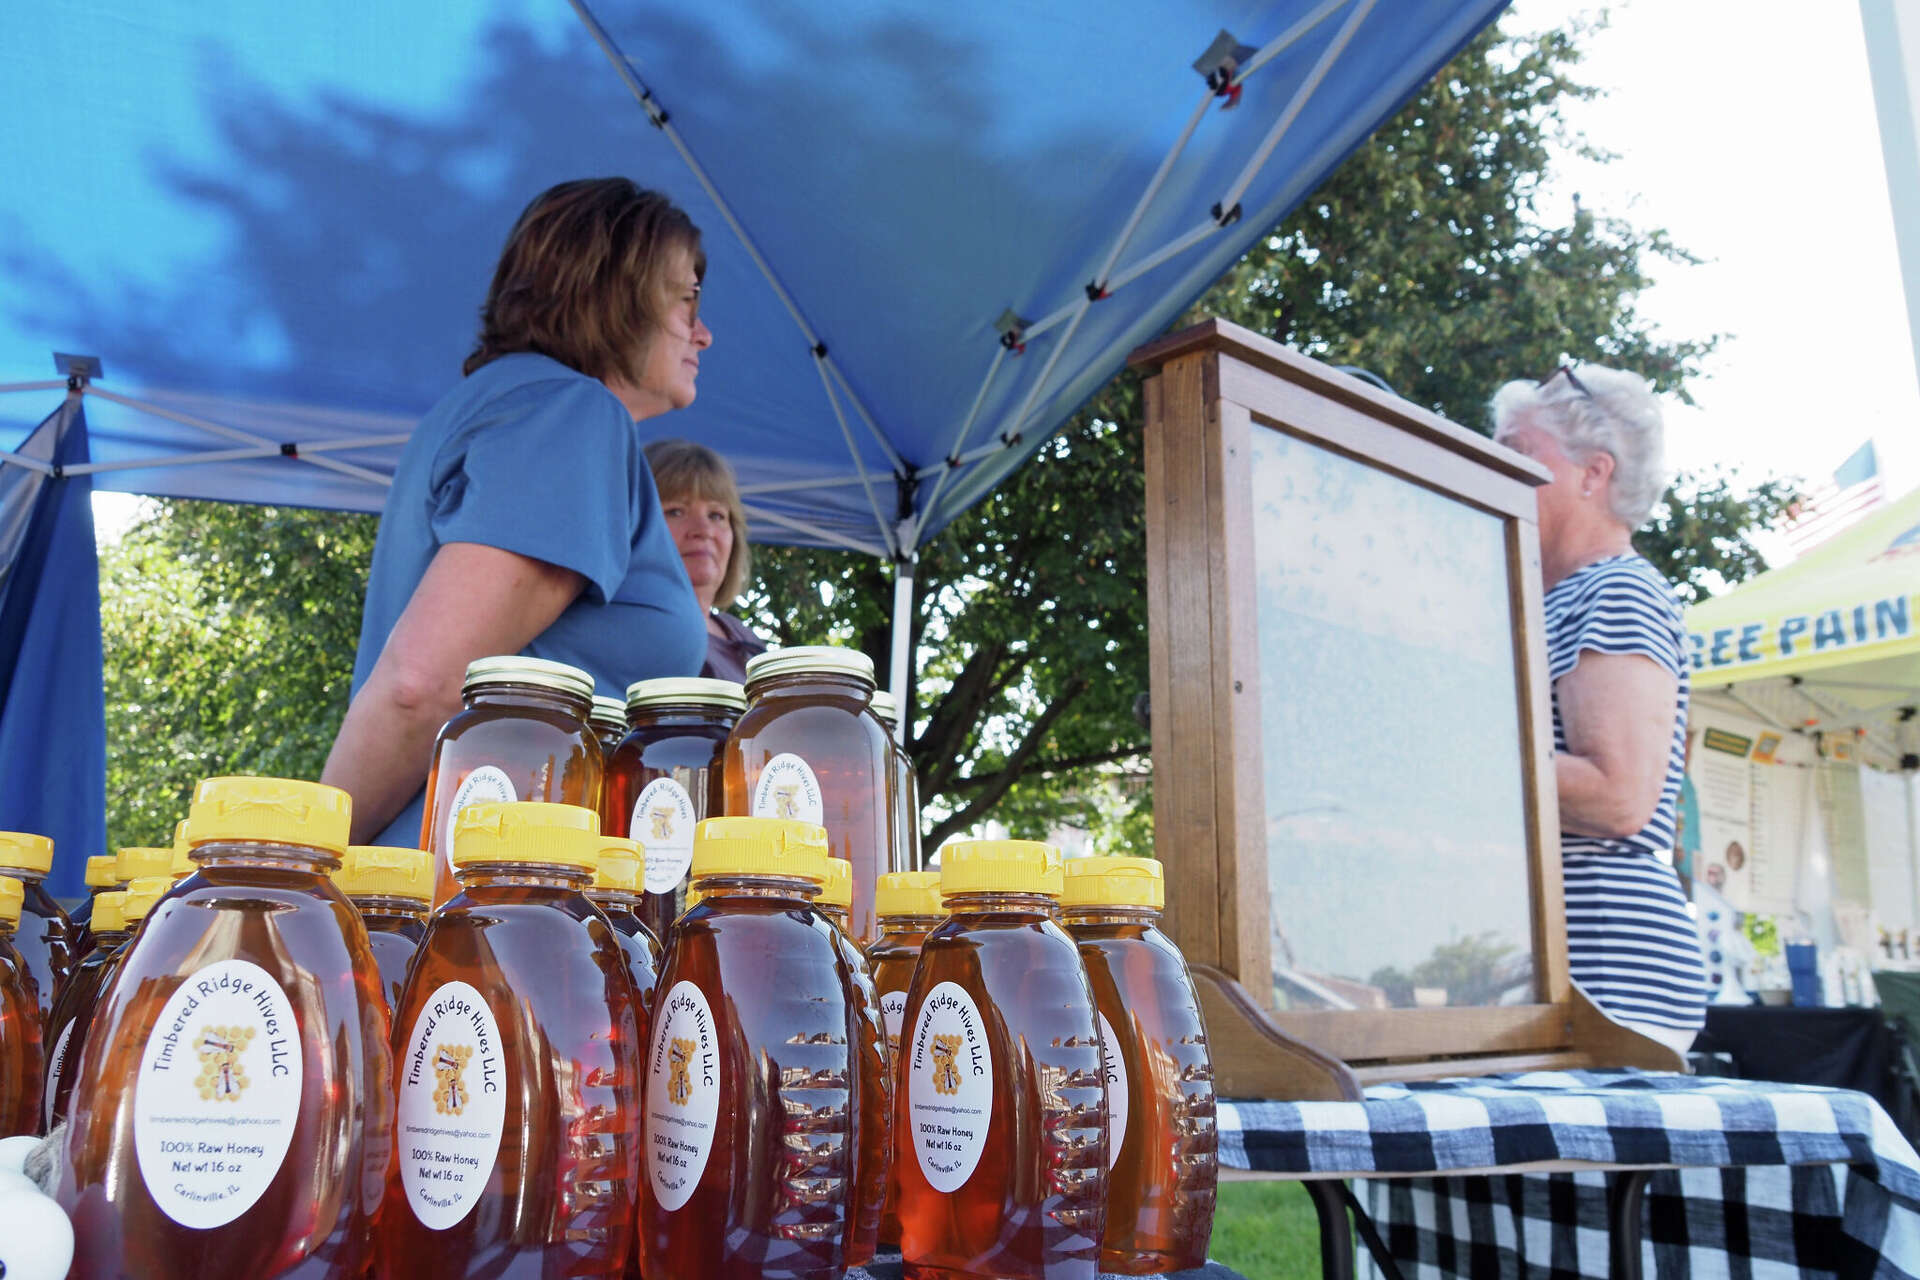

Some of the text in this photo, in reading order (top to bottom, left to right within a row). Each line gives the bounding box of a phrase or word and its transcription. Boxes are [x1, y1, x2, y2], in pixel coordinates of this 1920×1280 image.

[1778, 595, 1909, 655] PAIN
[883, 1000, 905, 1014] idg
[154, 973, 288, 1077] Timbered Ridge Hives LLC
[914, 993, 984, 1076] Timbered Ridge Hives LLC
[408, 995, 496, 1093] Timbered Ridge Hives LLC
[654, 993, 713, 1087] Timbered Ridge Hives LLC
[920, 1123, 973, 1141] 100% Raw Honey
[161, 1141, 263, 1158] 100% Raw Honey
[926, 1139, 935, 1149] Net
[936, 1141, 944, 1150] wt
[945, 1141, 952, 1150] 16
[172, 1161, 241, 1172] Net wt 16 oz
[412, 1149, 478, 1169] 100% Raw Honey
[419, 1168, 431, 1179] Net
[433, 1171, 441, 1180] wt
[444, 1170, 452, 1180] 16
